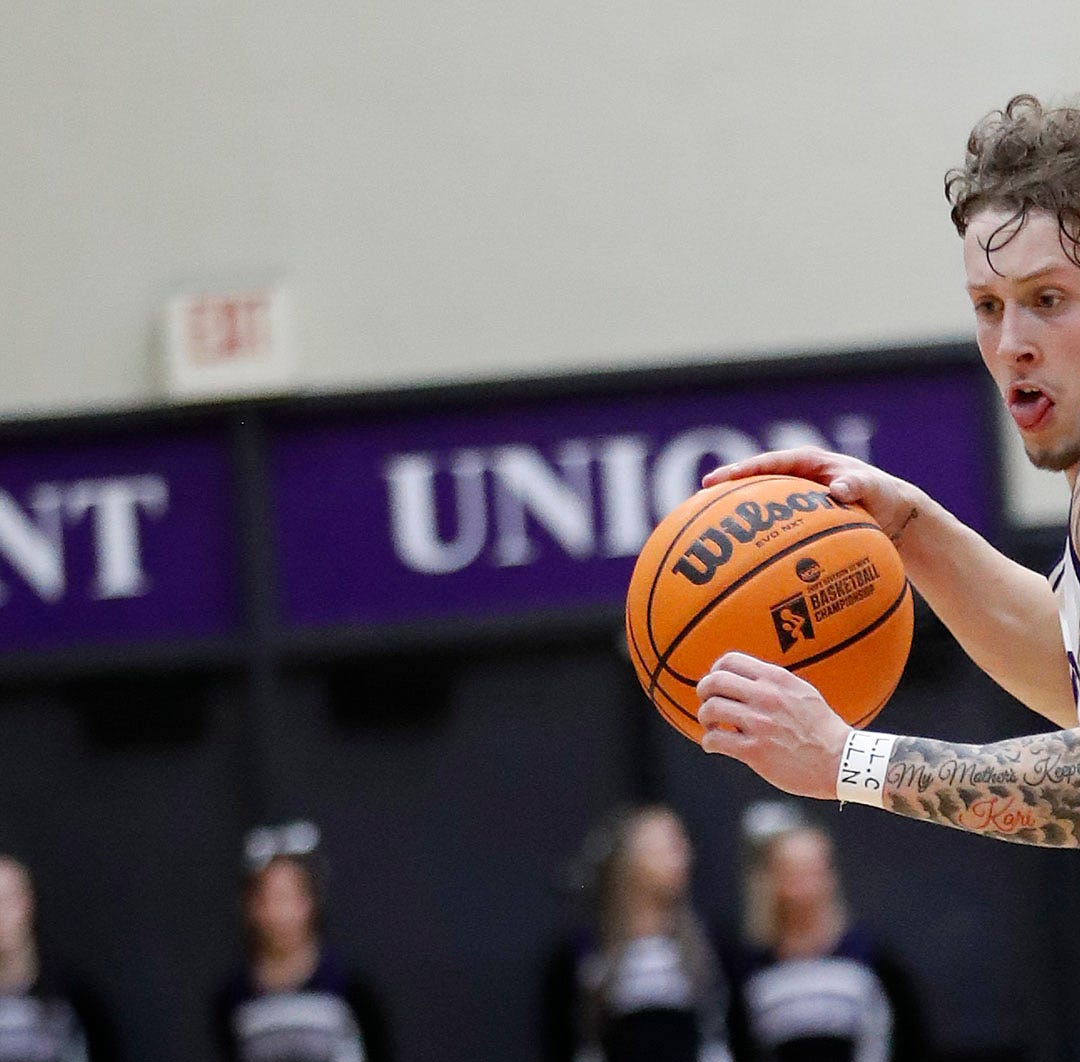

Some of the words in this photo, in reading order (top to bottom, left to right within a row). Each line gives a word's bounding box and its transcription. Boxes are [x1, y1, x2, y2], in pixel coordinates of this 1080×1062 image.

[388, 418, 874, 573] UNIO
[755, 530, 780, 549] EVO
[810, 563, 880, 610] BASKETBALL
[814, 584, 874, 622] CHAMPIONSHIP
[887, 761, 933, 792] My
